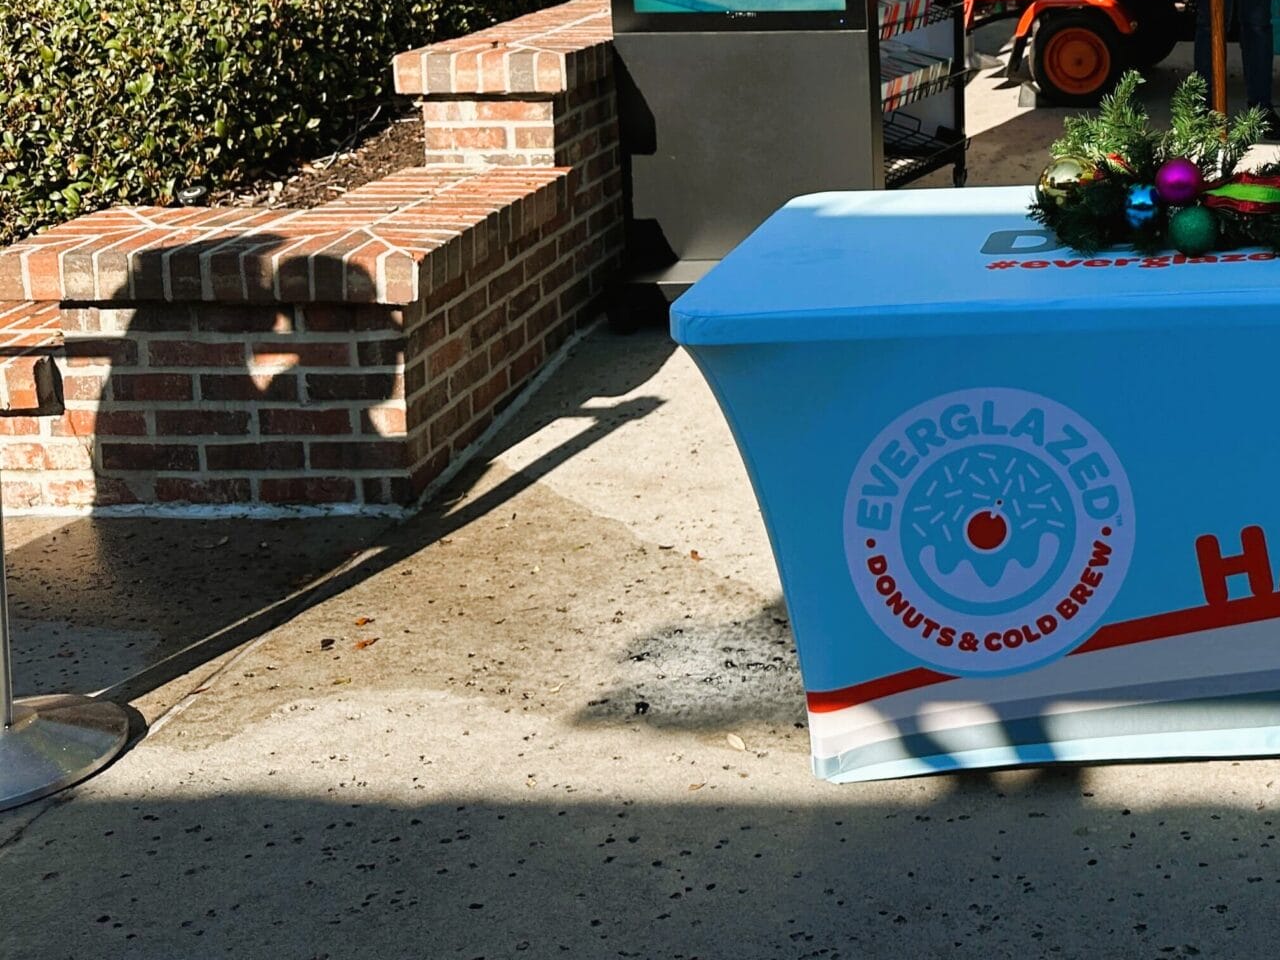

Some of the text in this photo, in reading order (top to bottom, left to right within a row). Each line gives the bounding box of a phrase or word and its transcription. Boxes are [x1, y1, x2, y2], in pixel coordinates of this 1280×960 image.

[985, 252, 1278, 269] #everglaze
[856, 400, 1120, 531] EVERGLAZED
[867, 540, 1113, 652] DONUTS & COLD BREW
